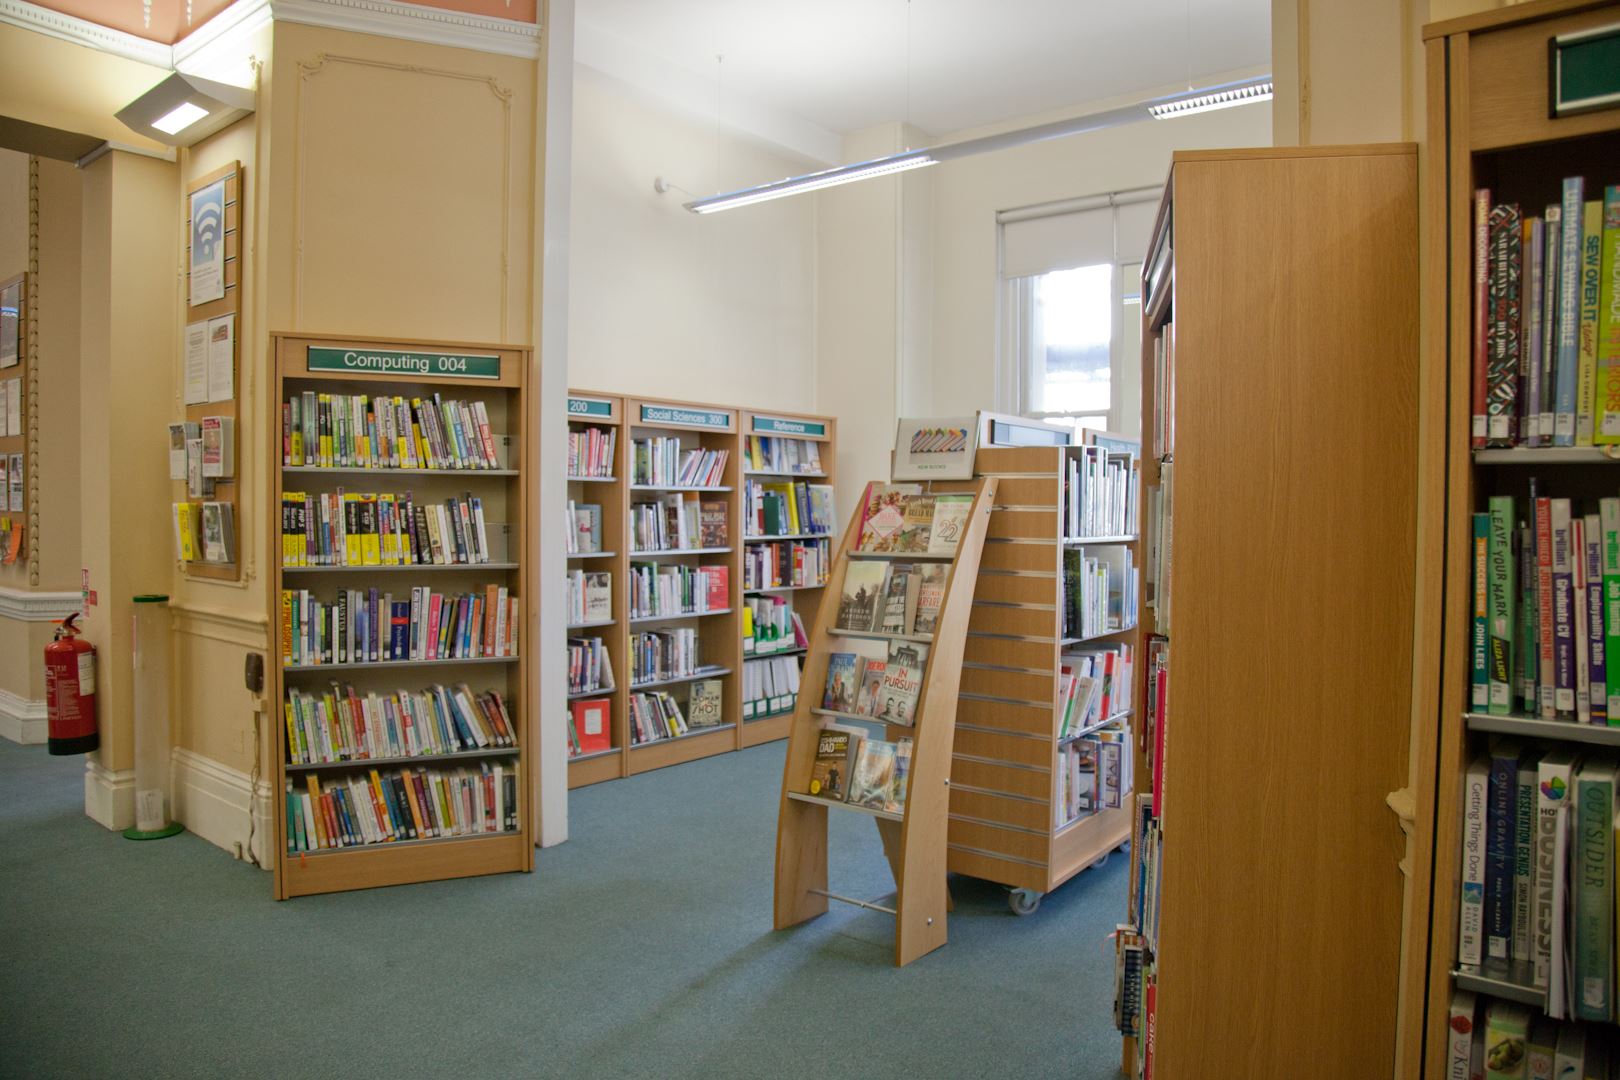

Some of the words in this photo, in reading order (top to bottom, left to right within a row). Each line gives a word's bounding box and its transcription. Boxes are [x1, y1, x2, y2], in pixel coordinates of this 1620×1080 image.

[1477, 198, 1488, 224] HOME
[1564, 188, 1578, 255] ULTIMATE
[1476, 226, 1488, 284] DECORATING
[1497, 232, 1508, 261] SARAH
[1586, 235, 1600, 265] SEW
[1563, 257, 1576, 309] SEWING
[1584, 268, 1599, 306] OVER
[1561, 311, 1574, 348] BIBLE
[1583, 307, 1598, 322] IT
[1496, 338, 1506, 359] JOBS
[1581, 322, 1593, 358] Vintage
[344, 352, 430, 373] Computing
[438, 357, 467, 372] 004
[570, 400, 587, 413] 200
[647, 408, 670, 420] Social
[673, 411, 706, 423] Sciences
[709, 414, 723, 425] 300
[773, 421, 805, 433] Reference
[1491, 509, 1508, 547] LEAVE
[1554, 529, 1568, 567] brilliant
[1588, 542, 1601, 578] brilliant
[1607, 531, 1620, 569] brilliant
[1475, 555, 1486, 594] SUCCESS
[1492, 550, 1508, 580] YOUR
[1539, 568, 1552, 587] JOB
[1492, 583, 1508, 617] MARK
[1555, 578, 1569, 623] Graduate
[1608, 579, 1620, 599] Job
[1540, 588, 1552, 628] HUNTING
[1589, 585, 1603, 640] Employability
[1608, 601, 1620, 637] Hunting
[1475, 622, 1486, 646] JOHN
[1542, 629, 1553, 661] ONLINE
[1556, 624, 1570, 638] CV
[1475, 647, 1485, 670] LEES
[1493, 639, 1506, 661] ALIZA
[1591, 642, 1603, 666] Skills
[885, 675, 919, 693] PURSUIT
[899, 667, 908, 678] IN
[692, 705, 718, 714] SHOT
[819, 743, 835, 753] DAD
[1467, 783, 1483, 819] Getting
[1497, 772, 1509, 816] ONLINE
[1517, 784, 1532, 844] PRESENTATION
[1466, 822, 1481, 854] Things
[1495, 819, 1507, 870] GRAVITY
[1585, 787, 1605, 889] OUTSIDER
[1468, 855, 1480, 881] Done
[1516, 846, 1530, 877] GENIUS
[1518, 883, 1528, 903] SIMON
